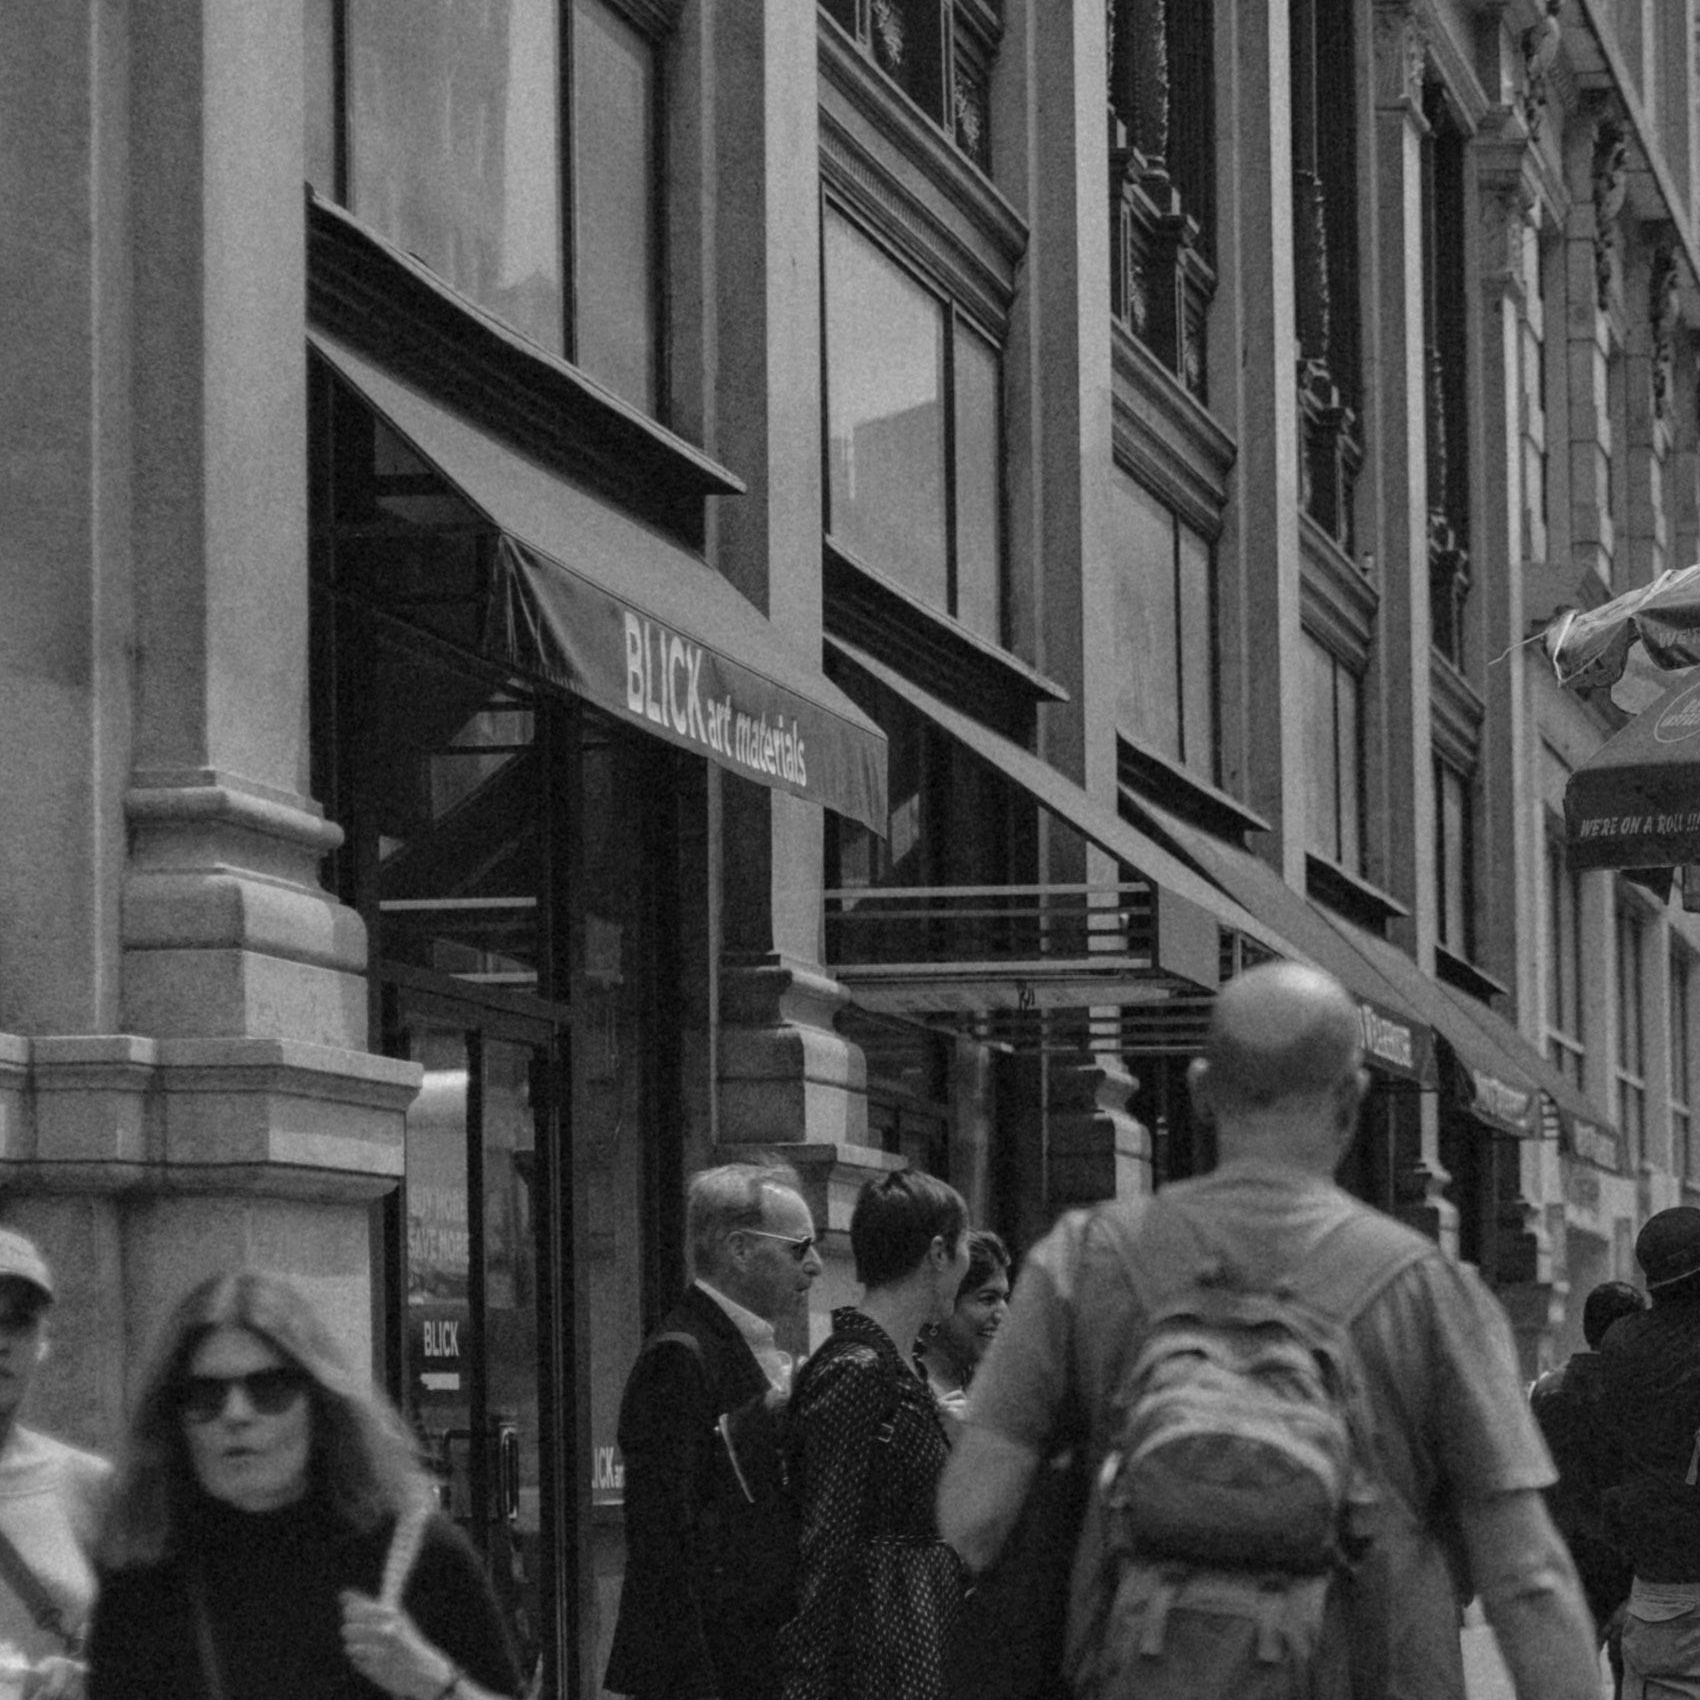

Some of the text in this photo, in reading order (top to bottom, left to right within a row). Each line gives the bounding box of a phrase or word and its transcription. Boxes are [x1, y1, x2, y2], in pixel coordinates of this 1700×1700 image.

[624, 610, 807, 787] BLICK art materials
[1620, 816, 1642, 835] ON
[1642, 815, 1653, 835] A
[423, 1320, 460, 1357] BLICK
